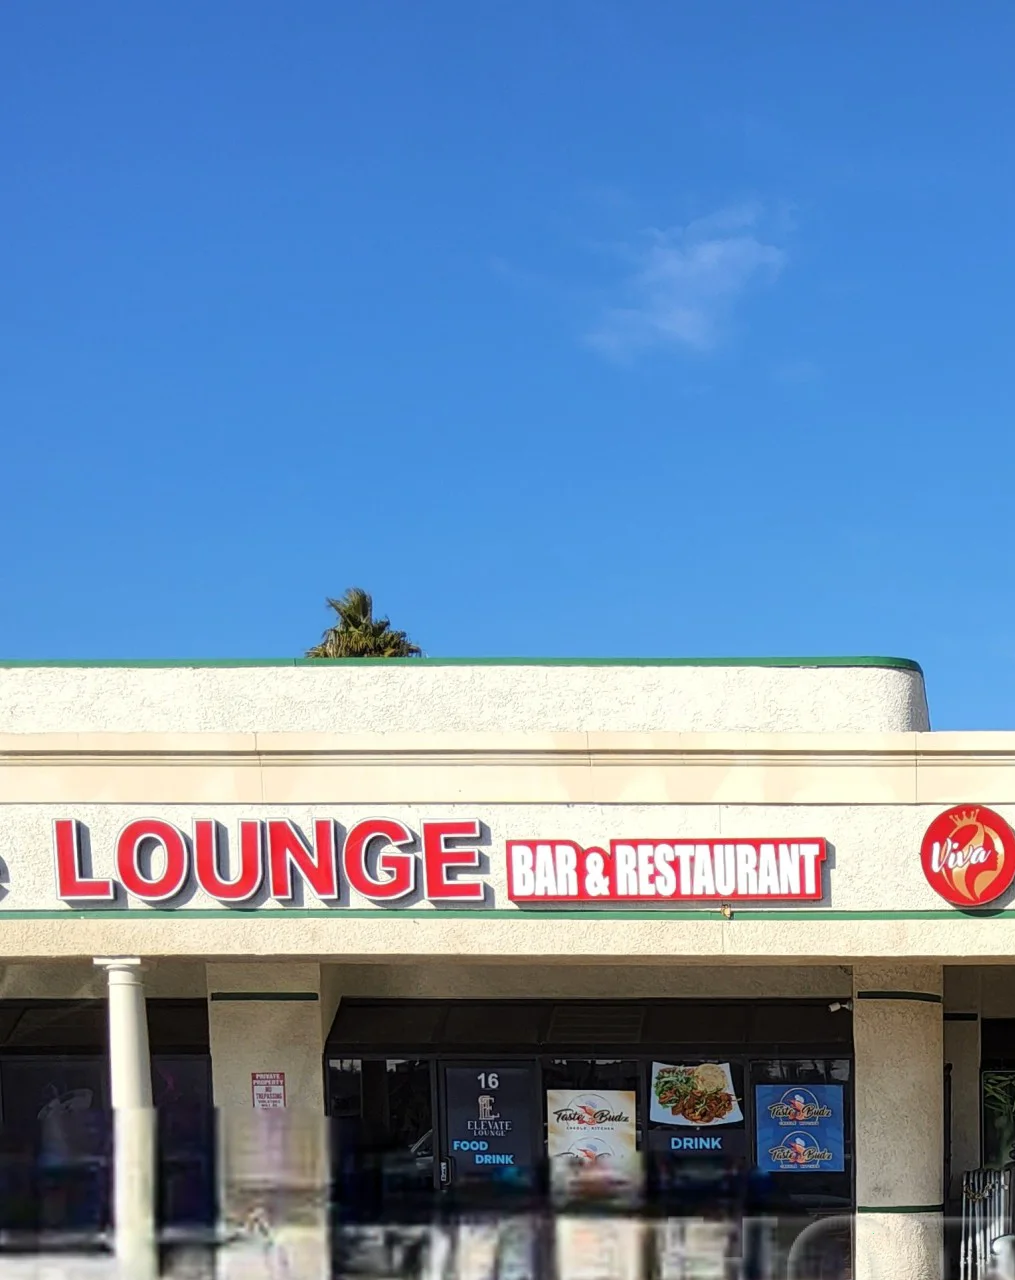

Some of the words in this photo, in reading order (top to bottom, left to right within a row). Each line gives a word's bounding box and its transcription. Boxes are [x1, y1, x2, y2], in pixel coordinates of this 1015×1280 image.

[53, 817, 485, 901] LOUNGE
[931, 840, 992, 873] Viva
[511, 844, 578, 896] BAR
[585, 851, 610, 897] &
[615, 843, 820, 896] RESTAURANT
[477, 1072, 499, 1089] 16
[553, 1108, 586, 1123] Taste
[593, 1109, 629, 1124] Budz
[768, 1102, 796, 1119] Taste
[802, 1103, 832, 1118] Budz
[467, 1120, 512, 1130] ELEVATE
[453, 1141, 489, 1151] FOOD
[671, 1137, 722, 1150] DRINK
[475, 1154, 514, 1164] DRINK
[768, 1145, 796, 1161] Taste
[802, 1146, 832, 1162] Budz
